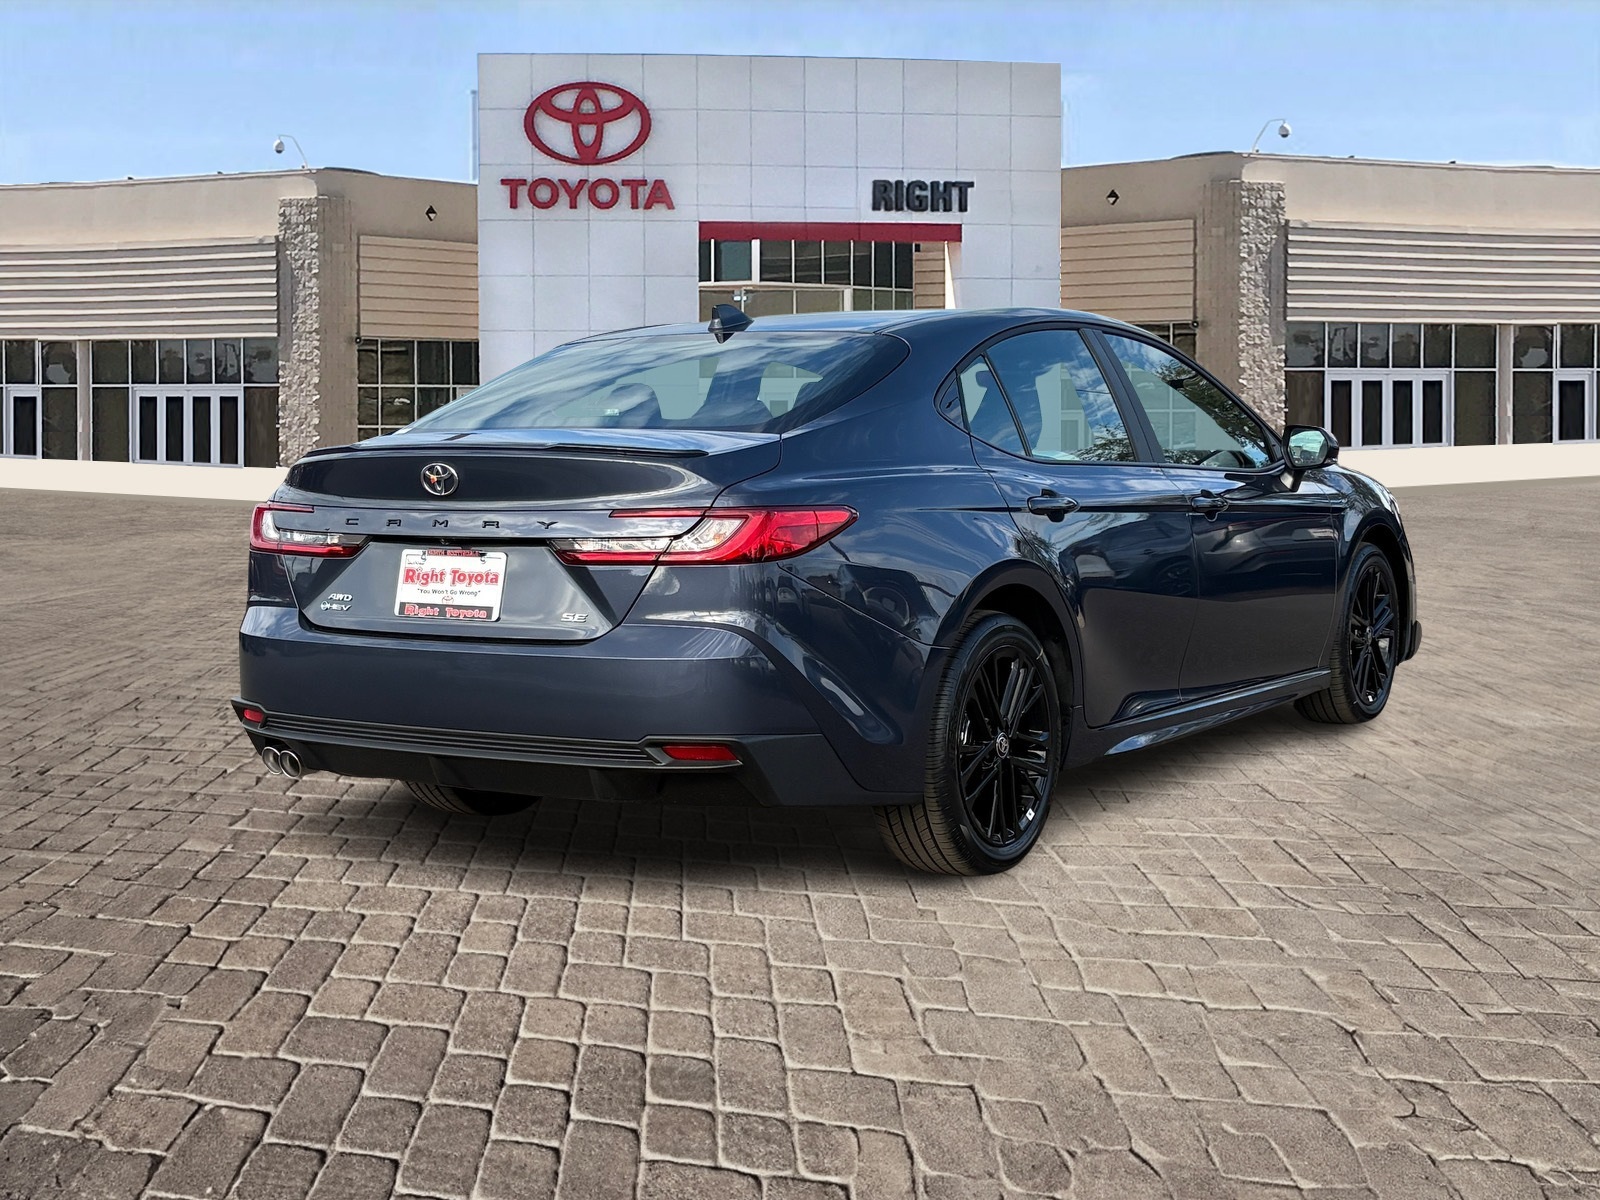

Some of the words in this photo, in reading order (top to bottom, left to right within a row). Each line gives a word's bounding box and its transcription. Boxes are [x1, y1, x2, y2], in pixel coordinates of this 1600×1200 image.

[500, 178, 675, 210] TOYOTA
[872, 179, 975, 212] RIGHT
[345, 518, 558, 529] CAMRY
[403, 566, 446, 586] Right
[450, 568, 499, 587] Toyota
[328, 593, 353, 601] AWD
[404, 603, 440, 617] Right
[445, 607, 487, 619] Toyota
[560, 612, 589, 623] SE
